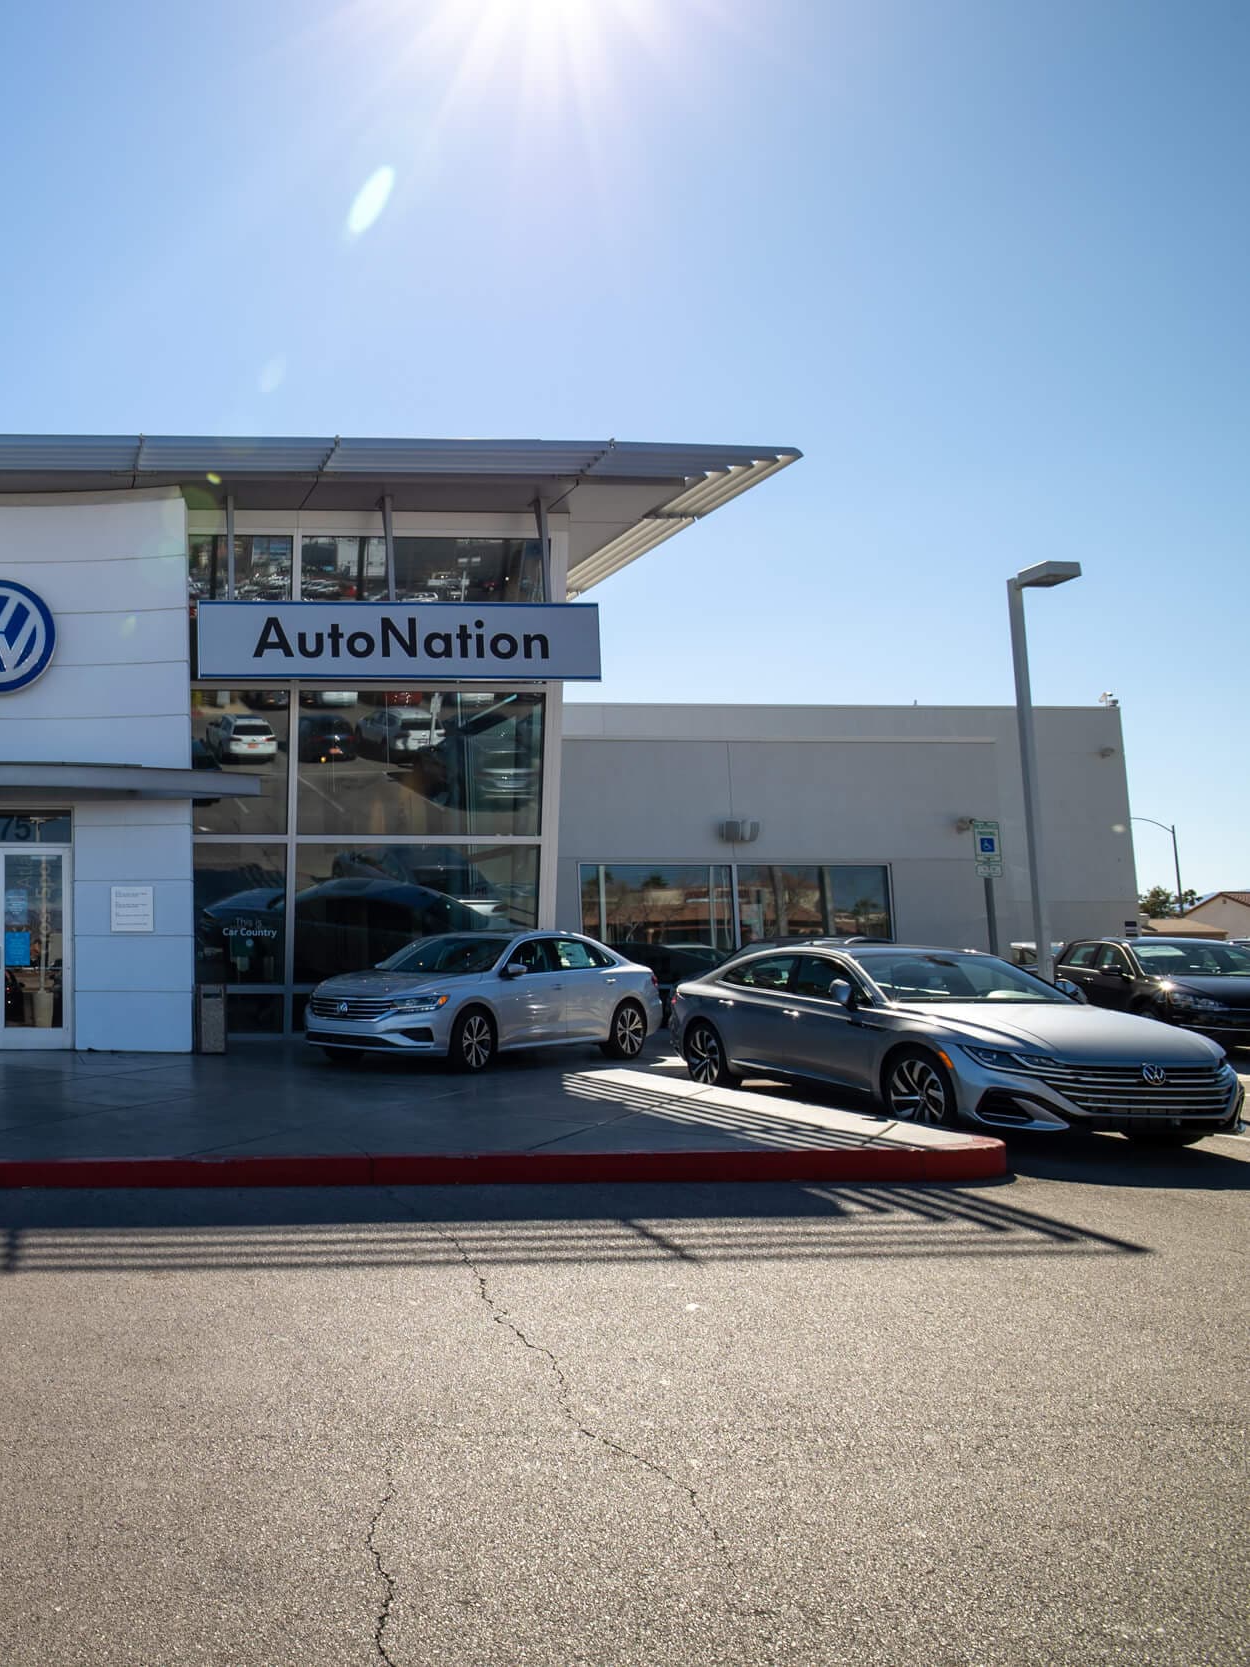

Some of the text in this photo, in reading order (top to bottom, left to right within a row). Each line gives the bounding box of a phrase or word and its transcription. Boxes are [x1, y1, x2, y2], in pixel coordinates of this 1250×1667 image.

[252, 616, 551, 660] AutoNation
[222, 928, 277, 938] Car Country
